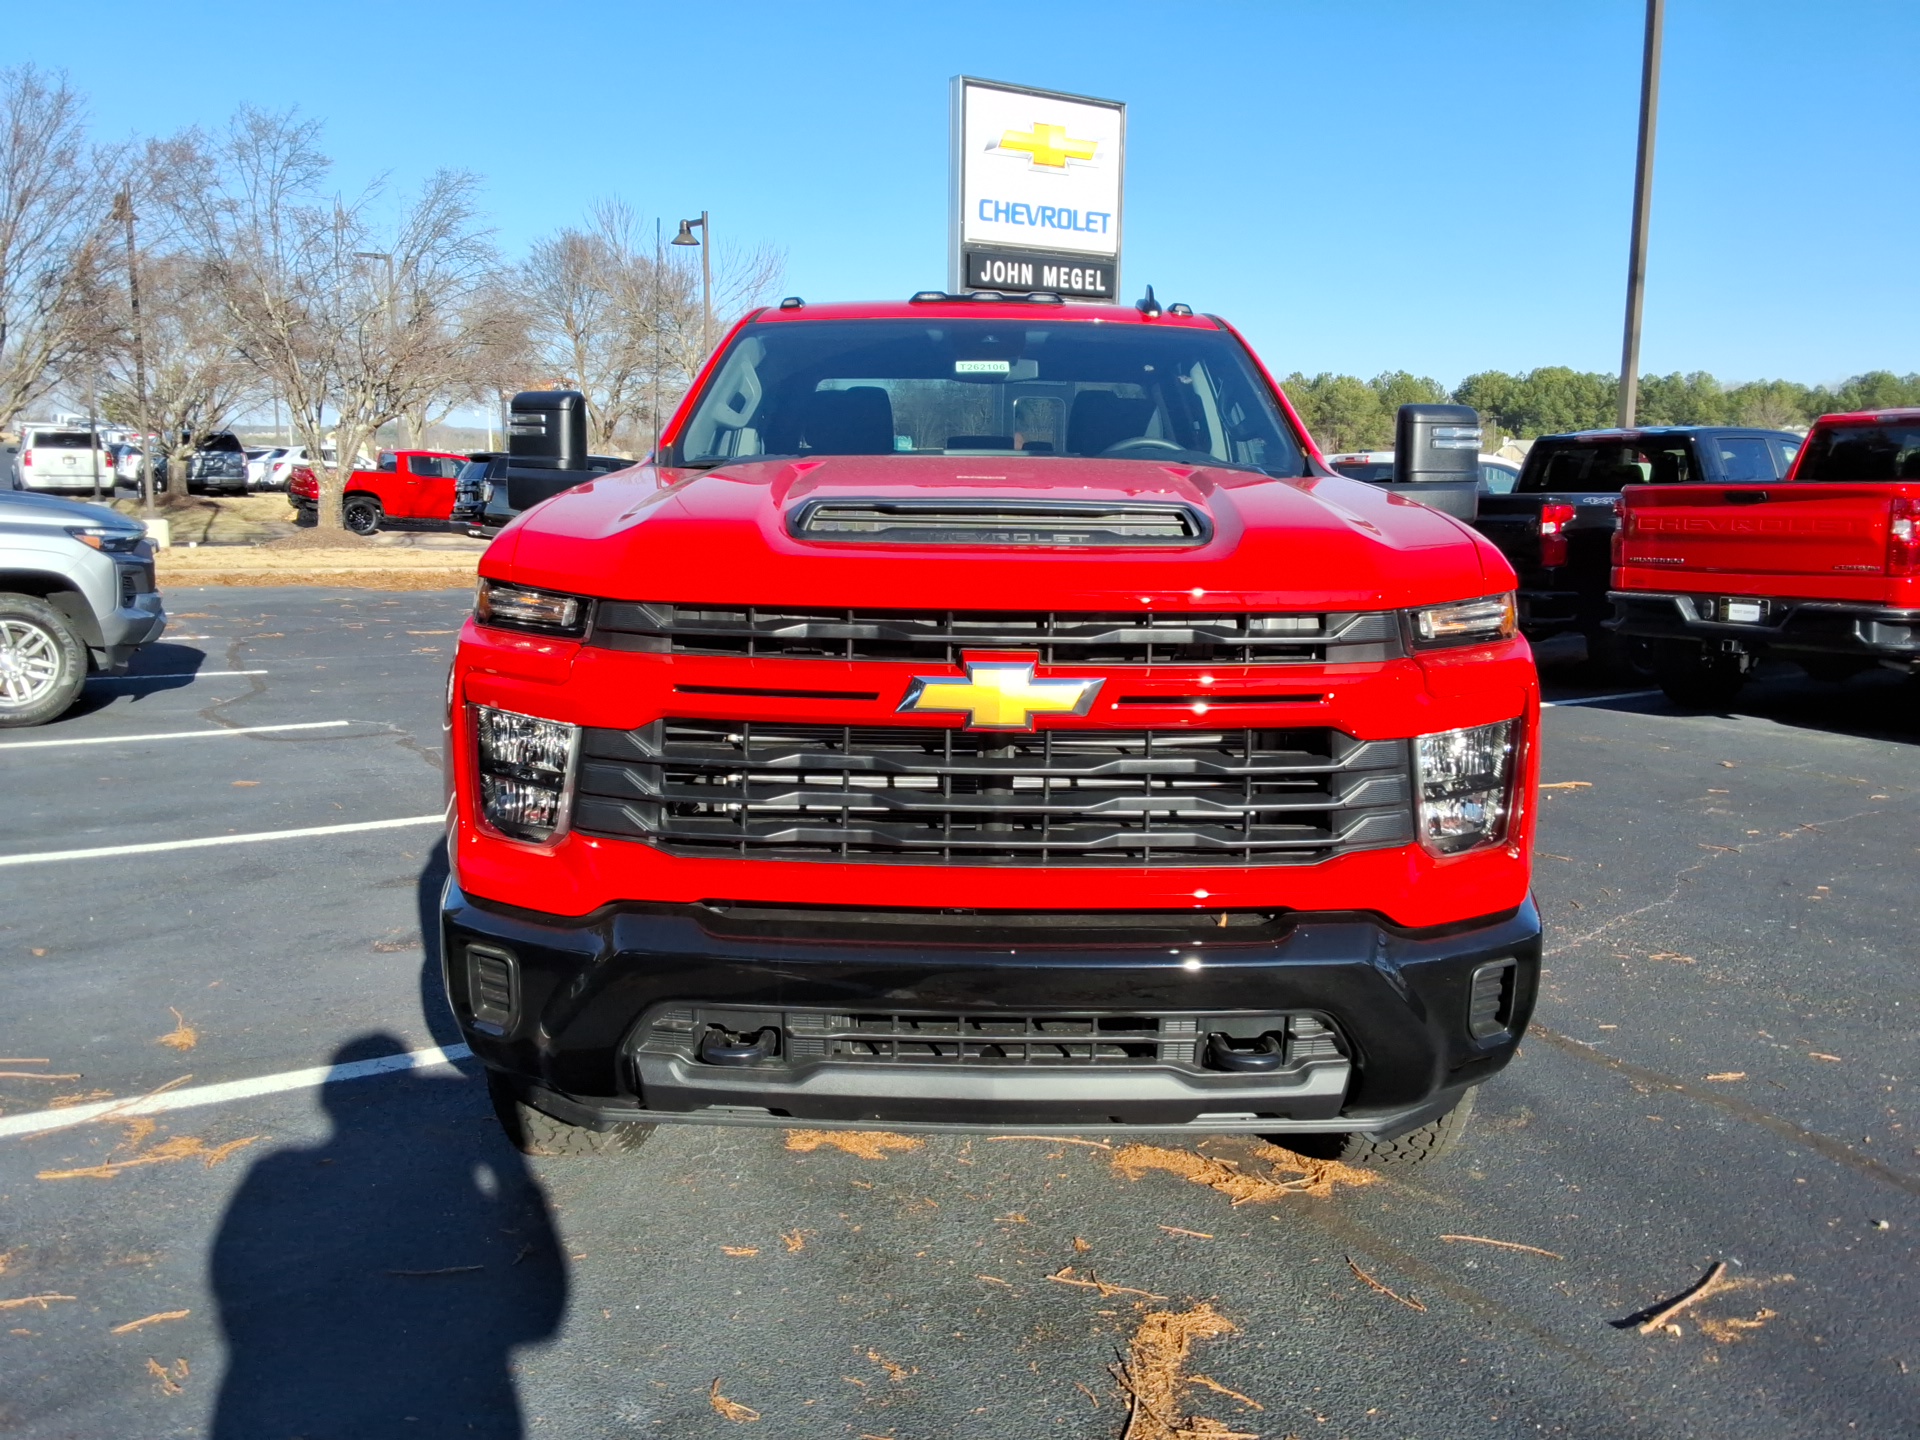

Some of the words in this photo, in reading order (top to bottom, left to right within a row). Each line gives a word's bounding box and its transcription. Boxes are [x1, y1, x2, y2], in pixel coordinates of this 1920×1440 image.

[979, 199, 1111, 234] CHEVROLET
[980, 260, 1033, 286] JOHN
[1043, 266, 1106, 291] MEGEL
[960, 363, 1006, 371] T262106
[1638, 517, 1862, 534] CHEVROLET
